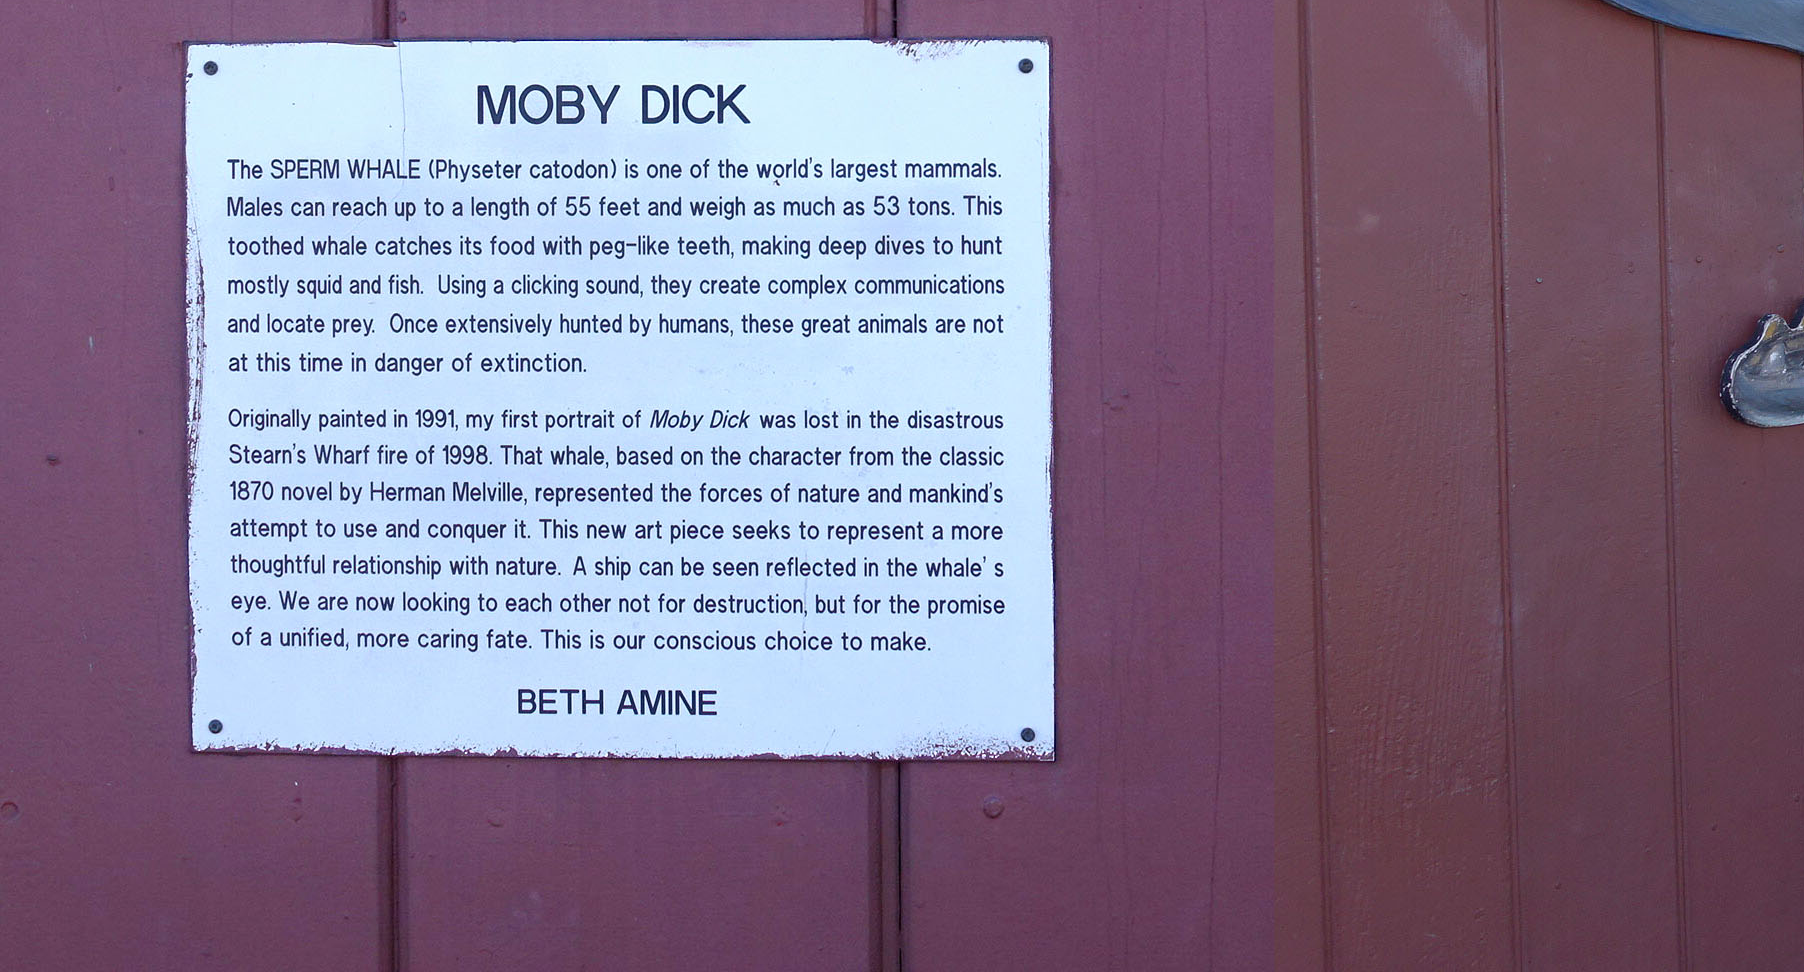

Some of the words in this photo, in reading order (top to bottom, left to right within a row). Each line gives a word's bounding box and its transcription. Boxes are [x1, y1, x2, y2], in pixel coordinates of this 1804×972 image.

[477, 83, 621, 125] MOBY
[641, 83, 751, 125] DICK
[226, 158, 264, 180] The
[270, 158, 340, 180] SPERM
[346, 158, 421, 180] WHALE
[428, 158, 522, 183] (Physeter
[529, 158, 617, 179] catodon)
[624, 158, 639, 179] is
[646, 163, 683, 179] one
[689, 158, 710, 179] of
[717, 158, 749, 179] the
[756, 156, 823, 180] world's
[831, 158, 898, 183] largest
[905, 157, 1001, 178] mammals.
[227, 235, 304, 256] toothed
[311, 235, 368, 256] whale
[374, 235, 453, 256] catches
[459, 235, 483, 256] its
[489, 235, 535, 256] food
[542, 235, 582, 256] with
[589, 235, 670, 261] peg-like
[677, 234, 735, 259] teeth,
[742, 235, 811, 260] making
[818, 235, 867, 261] deep
[874, 234, 925, 255] dives
[932, 235, 954, 255] to
[961, 234, 1003, 256] hunt
[227, 274, 290, 298] mostly
[296, 274, 343, 300] squid
[349, 274, 382, 295] and
[388, 274, 424, 295] fish.
[438, 274, 486, 299] Using
[493, 279, 505, 295] a
[511, 274, 579, 299] clicking
[585, 274, 644, 298] sound,
[650, 274, 692, 298] they
[699, 275, 761, 295] create
[767, 274, 847, 300] complex
[854, 275, 1005, 295] communications
[228, 353, 248, 372] at
[255, 351, 291, 372] this
[298, 351, 344, 373] time
[351, 351, 367, 373] in
[374, 352, 444, 377] danger
[451, 352, 473, 373] of
[480, 353, 587, 373] extinction.
[228, 408, 312, 432] Originally
[318, 408, 387, 433] painted
[393, 409, 408, 428] in
[414, 408, 459, 432] 1991,
[465, 413, 495, 432] my
[500, 409, 539, 429] first
[545, 410, 615, 433] portrait
[622, 409, 642, 429] of
[649, 409, 705, 432] Moby
[709, 409, 751, 429] Dick
[759, 414, 797, 429] was
[804, 409, 839, 429] lost
[846, 410, 862, 429] in
[868, 409, 900, 429] the
[907, 410, 1004, 430] disastrous
[228, 442, 307, 465] Stearn's
[313, 444, 370, 465] Wharf
[376, 444, 408, 465] fire
[415, 444, 435, 465] of
[442, 444, 493, 466] 1998.
[499, 444, 543, 466] That
[550, 444, 609, 469] whale,
[616, 445, 673, 466] based
[680, 450, 704, 466] on
[710, 445, 742, 466] the
[748, 445, 842, 466] character
[848, 445, 894, 466] from
[901, 445, 932, 466] the
[939, 445, 1005, 467] classic
[229, 480, 274, 501] 1870
[281, 481, 333, 501] novel
[339, 481, 363, 505] by
[370, 481, 446, 502] Herman
[452, 481, 528, 506] Melville,
[535, 482, 653, 508] represented
[660, 482, 692, 503] the
[699, 482, 763, 503] forces
[770, 482, 791, 503] of
[798, 483, 860, 504] nature
[867, 483, 902, 504] and
[909, 481, 1004, 504] mankind's
[230, 518, 308, 543] attempt
[315, 518, 336, 538] to
[343, 522, 378, 538] use
[385, 518, 420, 539] and
[427, 523, 507, 544] conquer
[514, 518, 531, 539] it.
[538, 518, 579, 539] This
[586, 523, 627, 540] new
[634, 520, 663, 540] art
[670, 520, 725, 545] piece
[732, 519, 791, 540] seeks
[798, 520, 820, 540] to
[827, 521, 924, 545] represent
[932, 525, 944, 541] a
[951, 524, 1004, 541] more
[230, 553, 326, 578] thoughtful
[332, 554, 442, 581] relationship
[449, 555, 489, 576] with
[495, 556, 561, 576] nature.
[572, 555, 587, 576] A
[594, 555, 632, 581] ship
[638, 561, 674, 577] can
[681, 556, 705, 577] be
[712, 561, 759, 577] seen
[766, 556, 856, 577] reflected
[864, 557, 879, 577] in
[886, 556, 918, 578] the
[231, 595, 271, 614] eye.
[278, 590, 310, 611] We
[317, 595, 349, 611] are
[355, 596, 395, 612] now
[402, 591, 470, 616] looking
[477, 593, 498, 613] to
[505, 592, 553, 613] each
[559, 592, 612, 613] other
[618, 594, 651, 613] not
[657, 592, 686, 614] for
[693, 593, 808, 618] destruction,
[815, 593, 846, 615] but
[852, 593, 882, 614] for
[888, 593, 921, 615] the
[927, 595, 1006, 620] promise
[517, 688, 604, 715] BETH
[616, 689, 718, 716] AMINE
